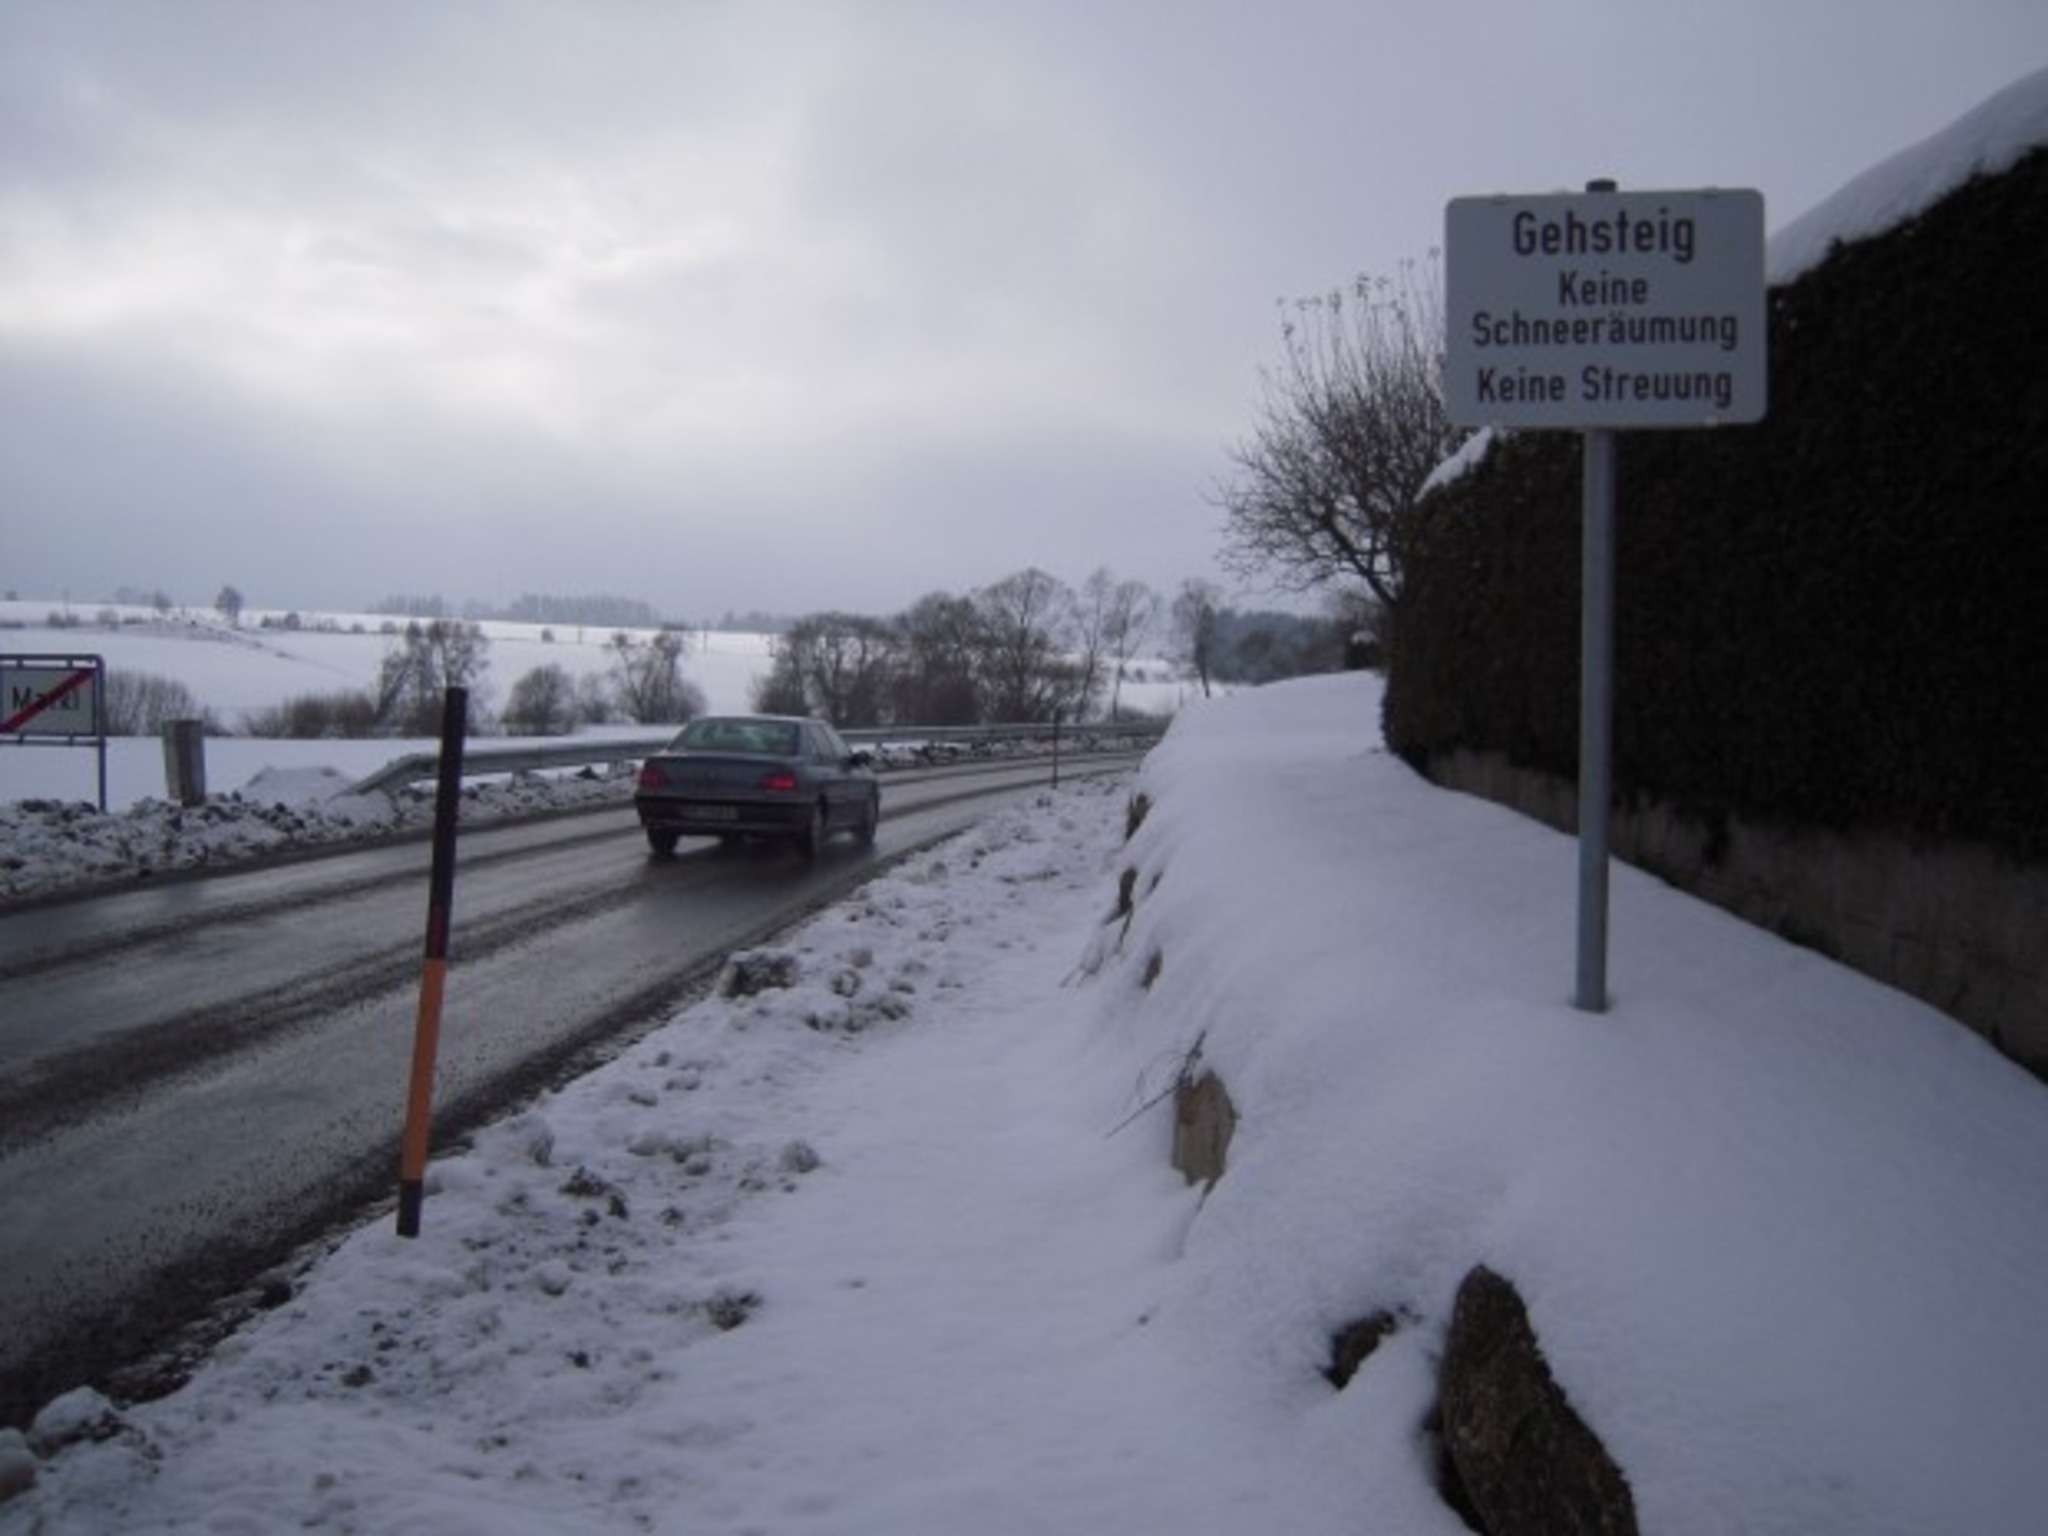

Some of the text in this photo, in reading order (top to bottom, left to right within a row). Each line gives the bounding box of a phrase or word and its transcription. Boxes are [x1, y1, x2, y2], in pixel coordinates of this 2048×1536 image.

[1513, 207, 1695, 264] Gehsteig
[1558, 270, 1649, 305] Keine
[1472, 309, 1737, 351] Schneeräumung
[1477, 365, 1732, 409] Keine Streuung
